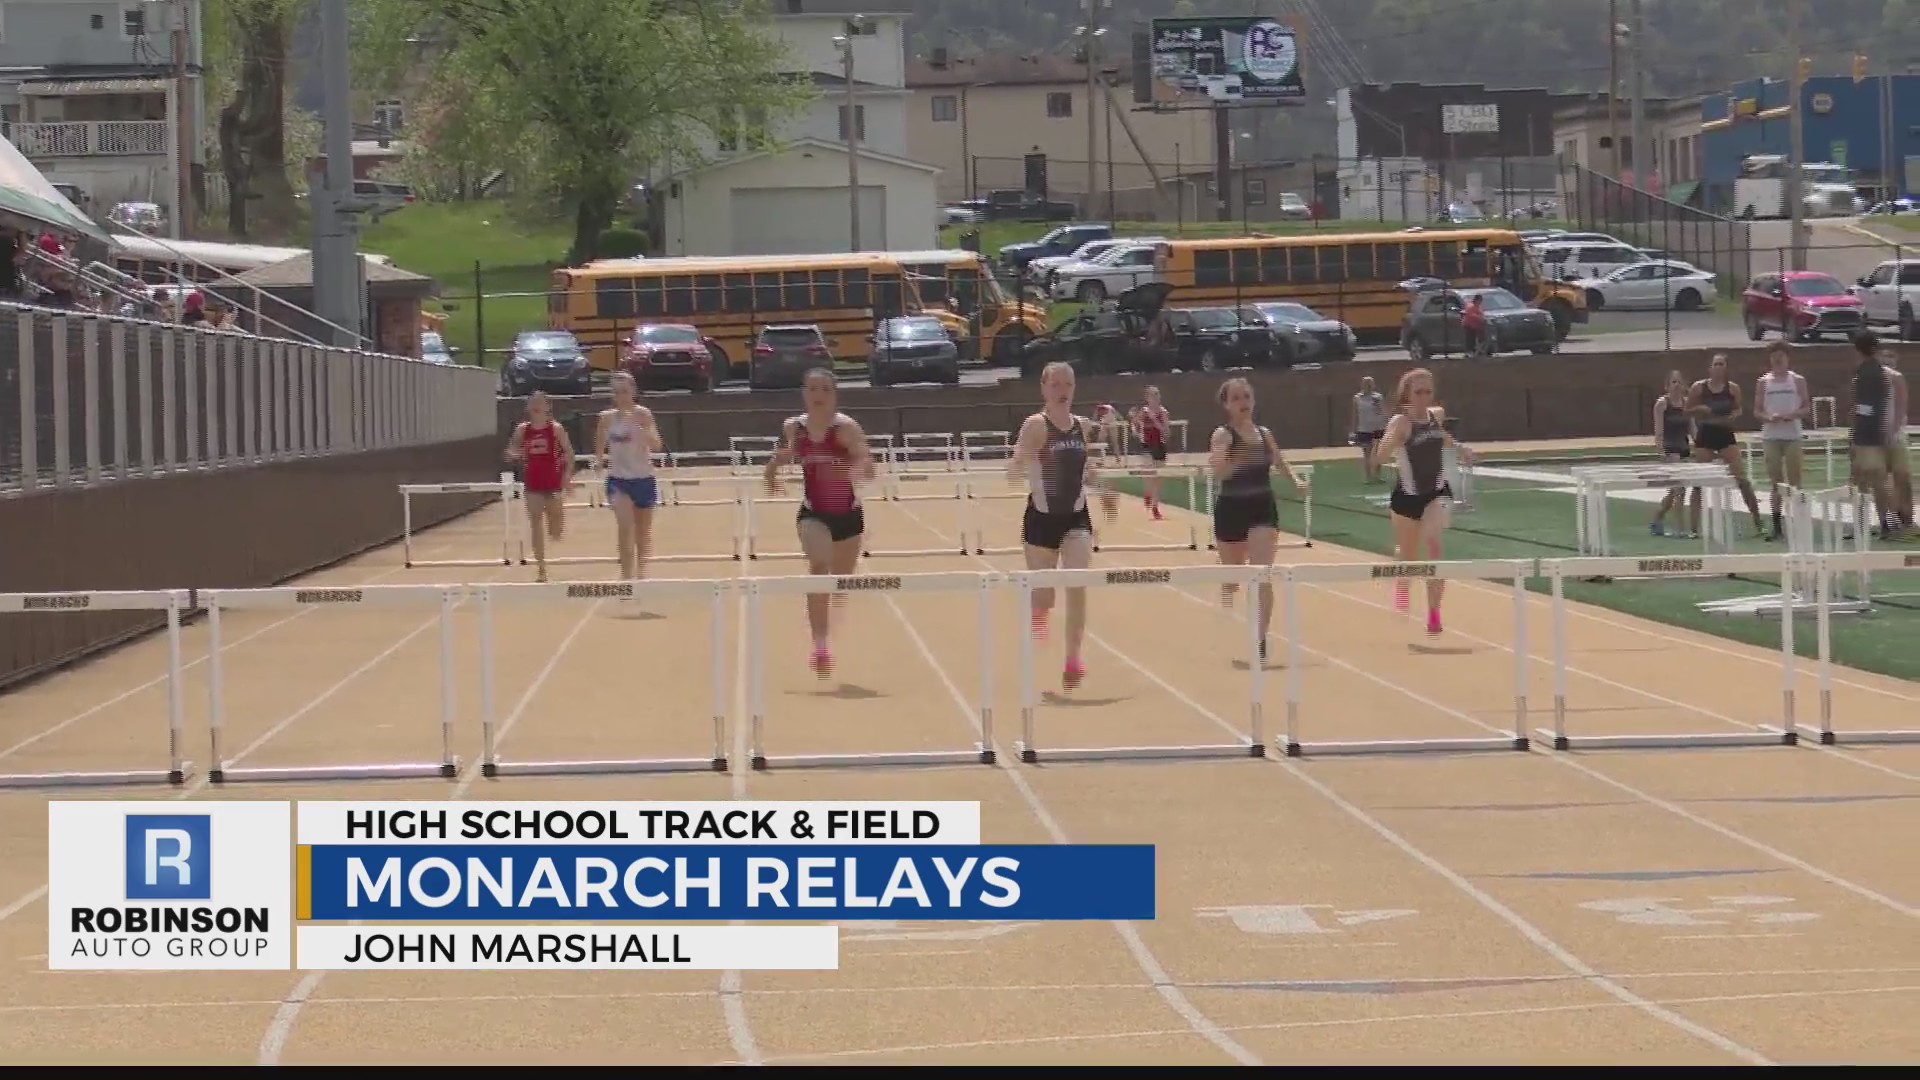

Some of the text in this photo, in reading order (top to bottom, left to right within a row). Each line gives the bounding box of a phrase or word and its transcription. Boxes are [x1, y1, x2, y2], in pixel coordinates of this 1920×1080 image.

[1638, 558, 1703, 573] MONARCHS
[836, 576, 901, 590] MONARCHS
[1106, 570, 1171, 584] MONARCHS
[296, 590, 362, 603] MONARCHS
[567, 584, 633, 599] MONARCHS
